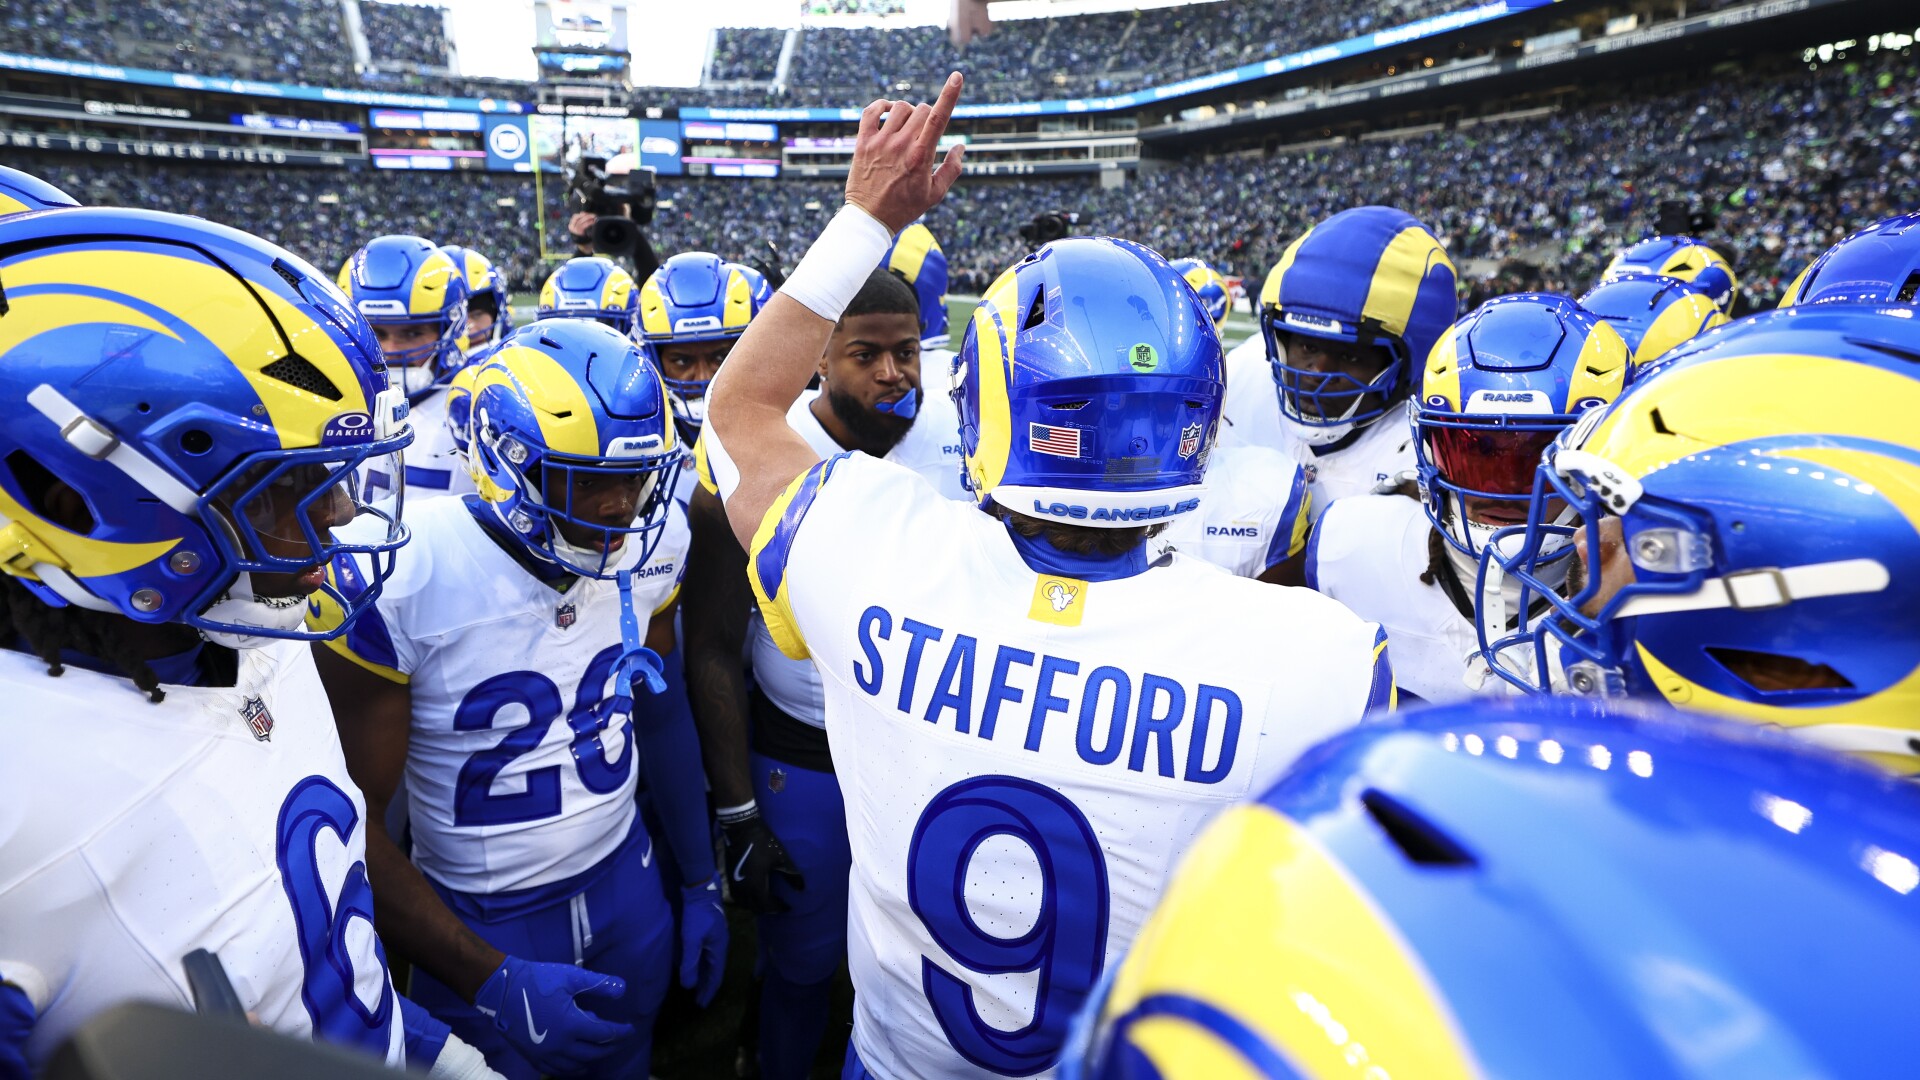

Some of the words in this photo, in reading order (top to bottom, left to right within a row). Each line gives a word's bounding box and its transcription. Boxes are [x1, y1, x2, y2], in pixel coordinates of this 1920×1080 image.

[69, 134, 102, 153] TO
[118, 139, 205, 160] LUMEN
[218, 145, 287, 164] FIELD
[1482, 393, 1533, 403] RAMS
[326, 428, 373, 438] OAKLEY
[624, 440, 659, 450] RAMS
[942, 441, 961, 455] RA
[1034, 499, 1088, 519] LOS
[1091, 497, 1200, 521] ANGELES
[1207, 526, 1258, 537] RAMS
[637, 562, 674, 580] RAMS
[853, 605, 1243, 785] STAFFORD
[276, 774, 394, 1060] 6
[907, 774, 1111, 1078] 9
